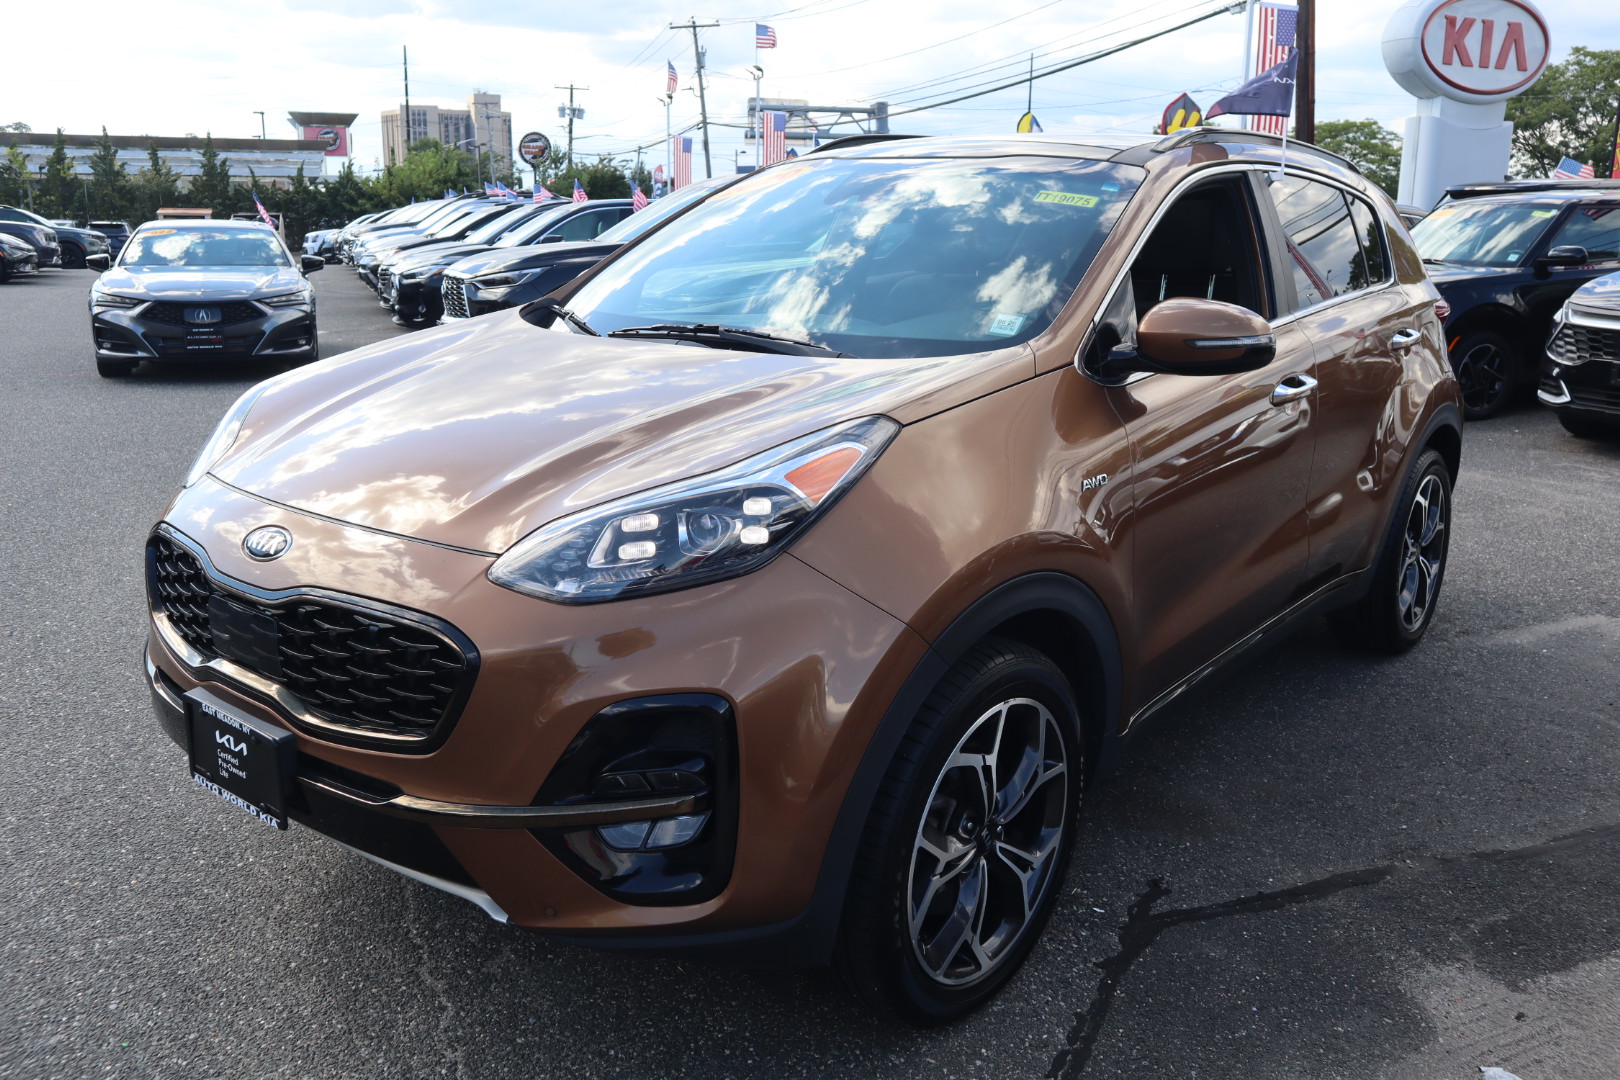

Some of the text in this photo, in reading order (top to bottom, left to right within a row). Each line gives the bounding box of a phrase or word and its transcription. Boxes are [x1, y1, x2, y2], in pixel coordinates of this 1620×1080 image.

[1442, 14, 1528, 72] KIA
[1082, 473, 1109, 492] AWD
[246, 529, 286, 555] KIA
[201, 703, 216, 717] EAST
[242, 724, 251, 735] NY
[217, 748, 239, 766] Certified
[218, 758, 247, 779] Pre-Owned
[219, 768, 229, 779] Lite
[194, 774, 279, 829] AUTO WORLD KIA
